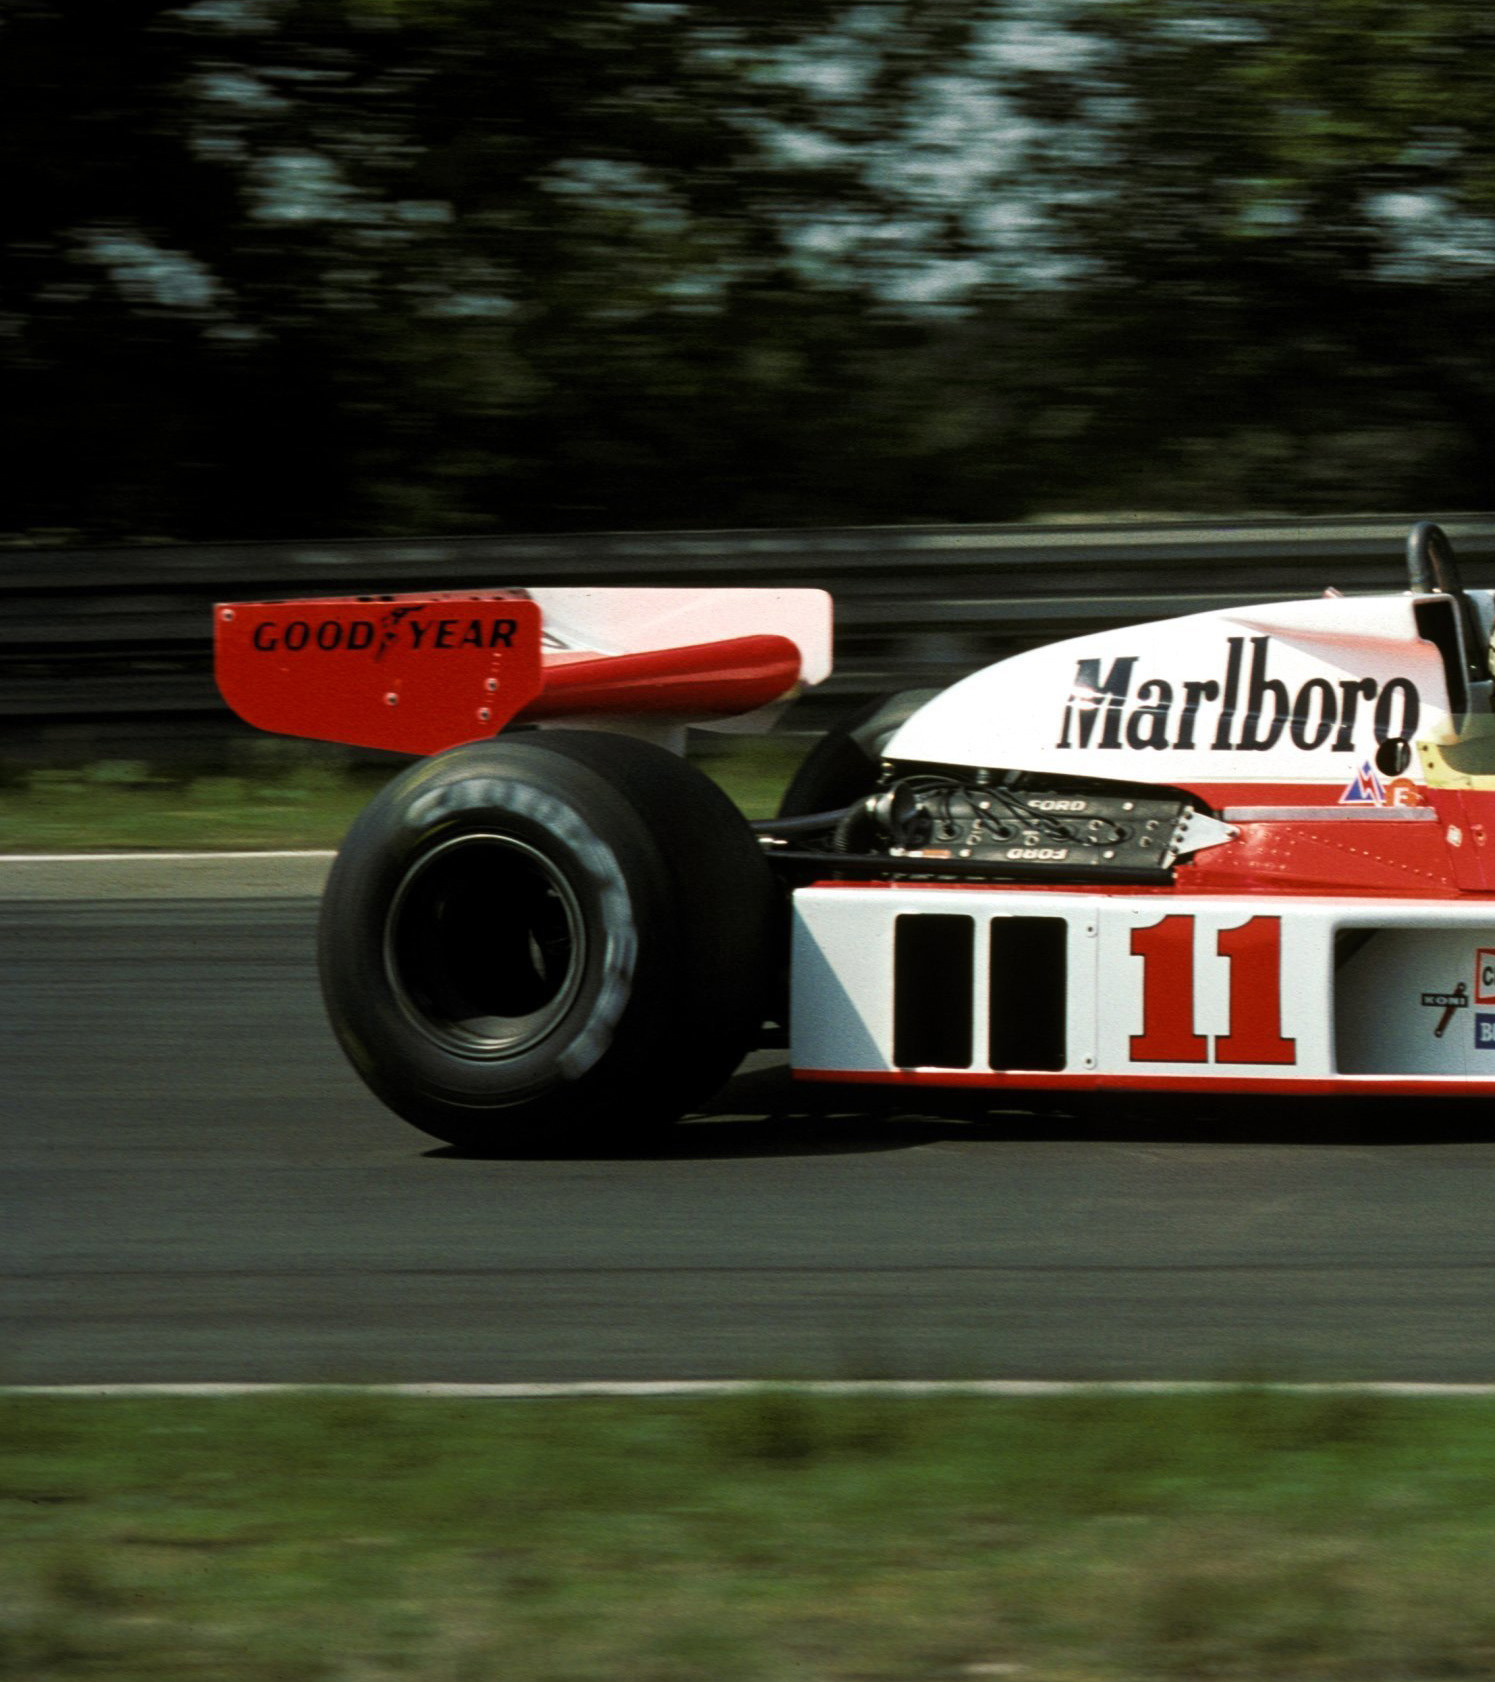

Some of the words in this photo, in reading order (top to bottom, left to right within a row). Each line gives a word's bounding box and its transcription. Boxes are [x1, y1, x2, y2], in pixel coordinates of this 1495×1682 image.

[253, 621, 375, 652] GOOD
[408, 618, 518, 650] YEAR
[1056, 636, 1421, 753] Marlboro
[1006, 848, 1068, 860] FORD
[1129, 914, 1297, 1065] 11
[1423, 996, 1466, 1006] KONI
